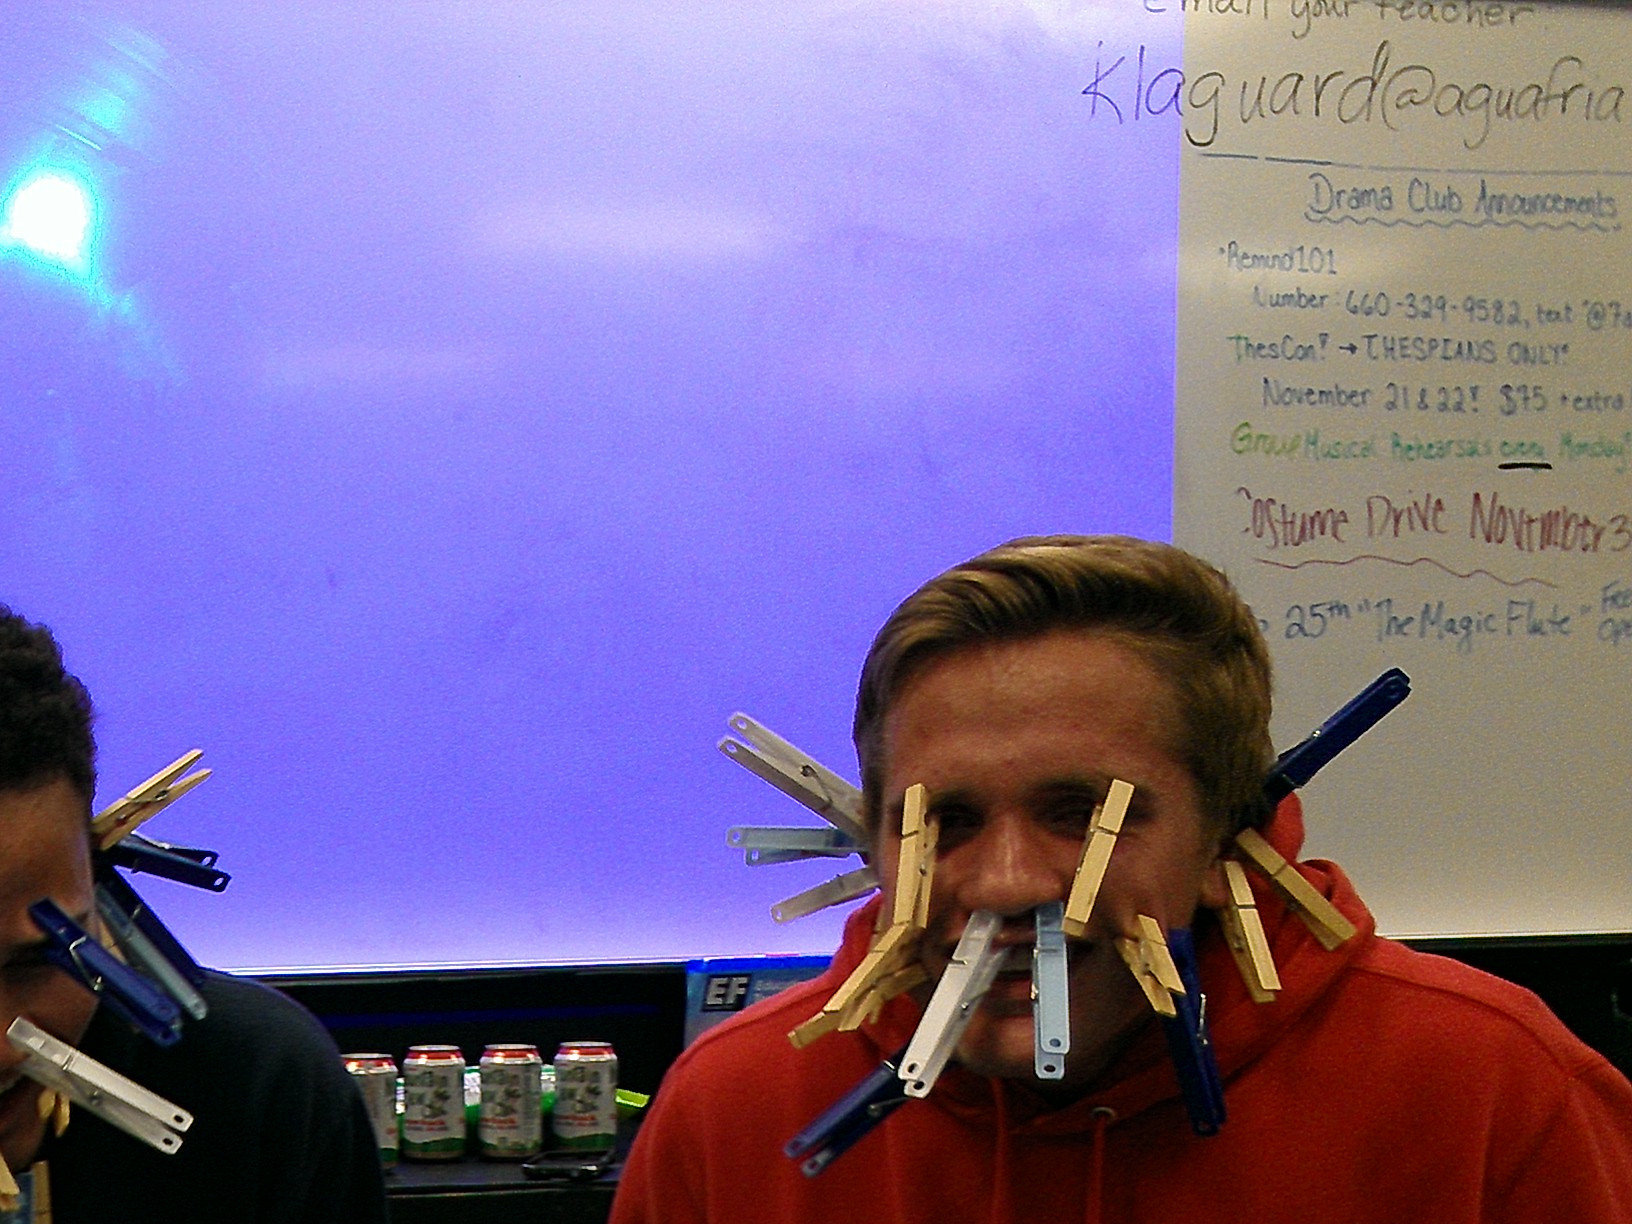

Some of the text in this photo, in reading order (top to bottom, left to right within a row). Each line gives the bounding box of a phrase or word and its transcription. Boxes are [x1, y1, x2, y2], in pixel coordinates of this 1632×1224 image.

[1291, 0, 1352, 39] your
[1378, 0, 1532, 27] teacher
[1308, 172, 1393, 214] Drama
[1408, 177, 1464, 213] Club
[1361, 333, 1497, 364] THESPIANS
[1262, 379, 1371, 412] November
[1235, 486, 1350, 550] ostume
[1367, 487, 1450, 540] Drive
[706, 977, 748, 1004] EF
